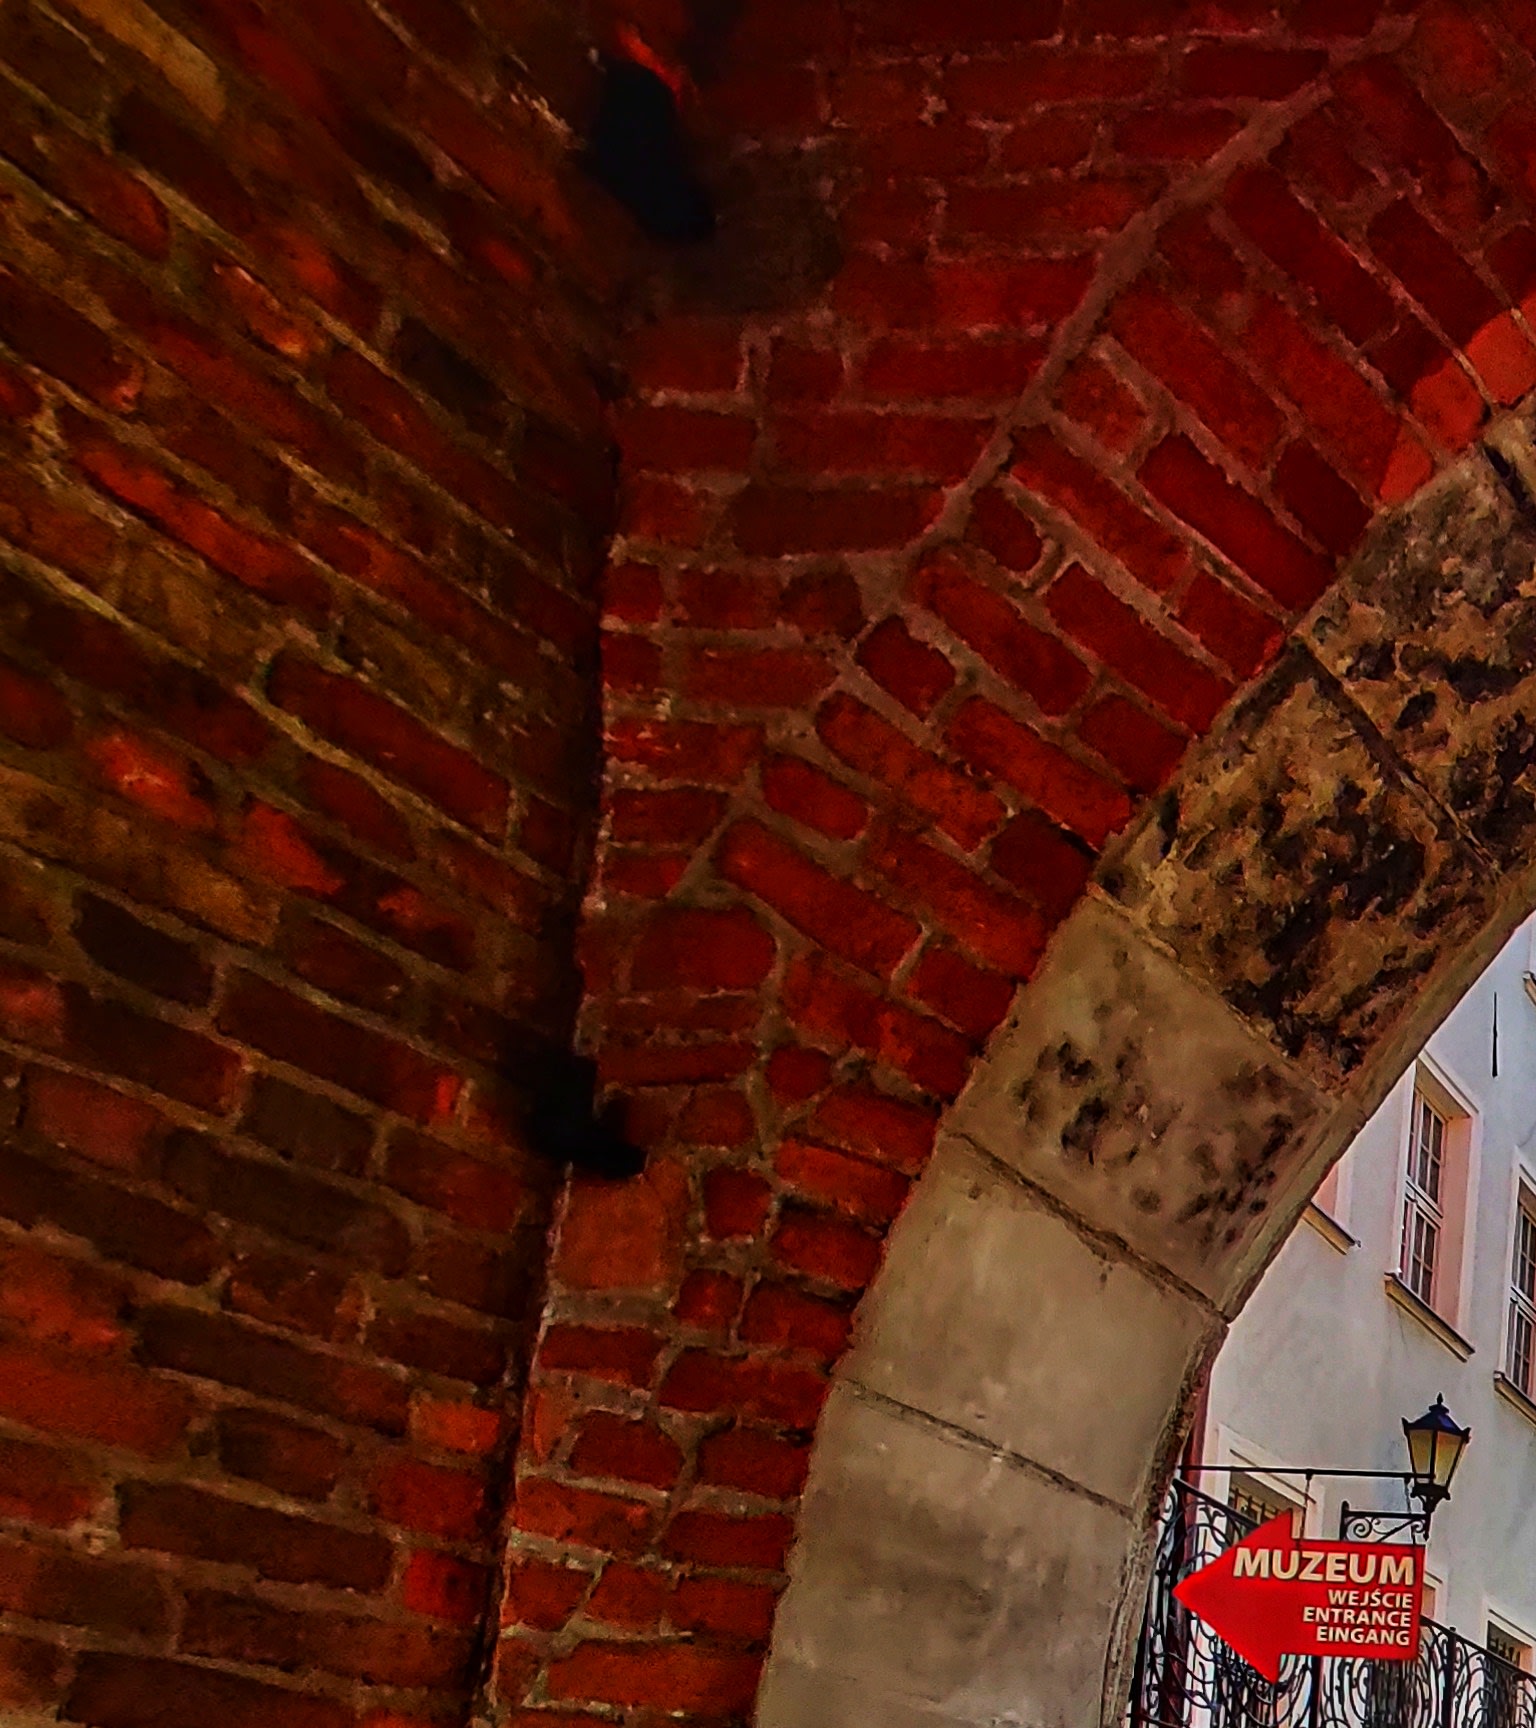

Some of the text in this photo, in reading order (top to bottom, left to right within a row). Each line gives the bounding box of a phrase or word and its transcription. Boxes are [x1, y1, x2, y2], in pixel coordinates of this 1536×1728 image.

[1233, 1547, 1415, 1586] MUZEUM
[1327, 1588, 1413, 1609] WEJŚCIE
[1302, 1606, 1412, 1628] ENTRANCE
[1315, 1625, 1411, 1646] EINGANG
